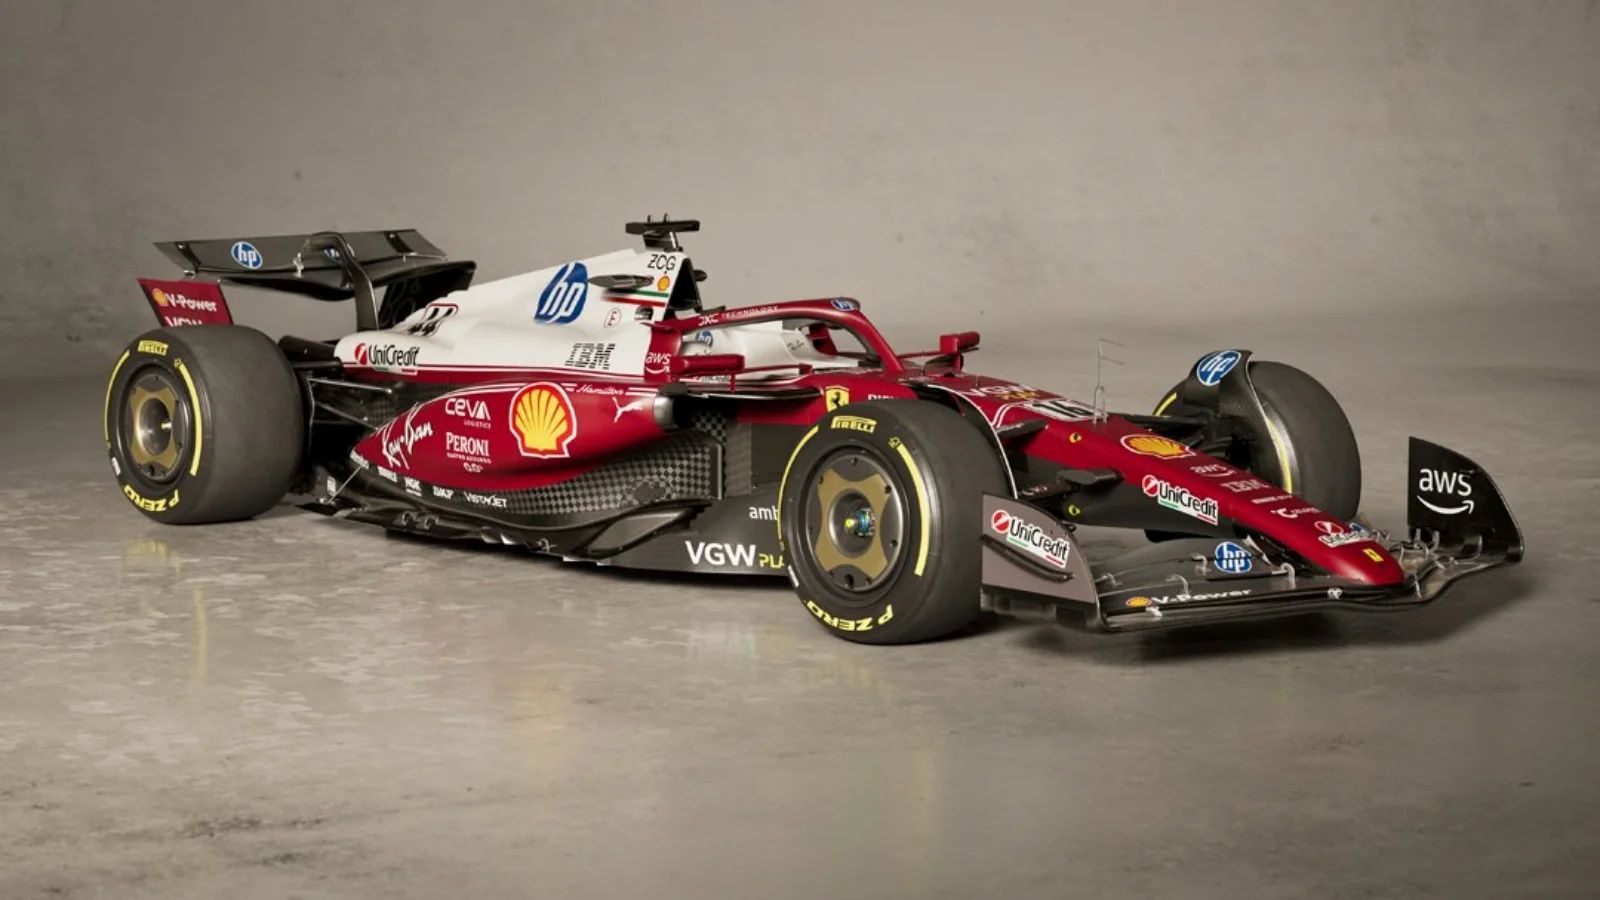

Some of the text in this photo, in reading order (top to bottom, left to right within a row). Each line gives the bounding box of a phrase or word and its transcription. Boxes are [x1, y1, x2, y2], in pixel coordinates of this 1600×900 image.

[234, 242, 260, 269] hp
[165, 293, 217, 312] V-Power
[538, 262, 588, 324] hp
[721, 306, 778, 319] TECHNOLOGY
[368, 344, 420, 367] UniCredit
[565, 343, 616, 370] IBM
[645, 351, 671, 365] aws
[1199, 350, 1239, 386] hp
[576, 383, 624, 396] Hamilton
[830, 415, 878, 434] PIRELLI
[446, 431, 489, 456] PERONI
[1418, 468, 1472, 496] aws
[123, 484, 167, 512] ZERO
[1159, 483, 1217, 518] UniCredit
[1010, 519, 1069, 560] UniCredit
[685, 541, 756, 567] VGW
[1218, 542, 1251, 573] hp
[1151, 589, 1252, 604] V-Power
[806, 600, 894, 631] P ZERO
